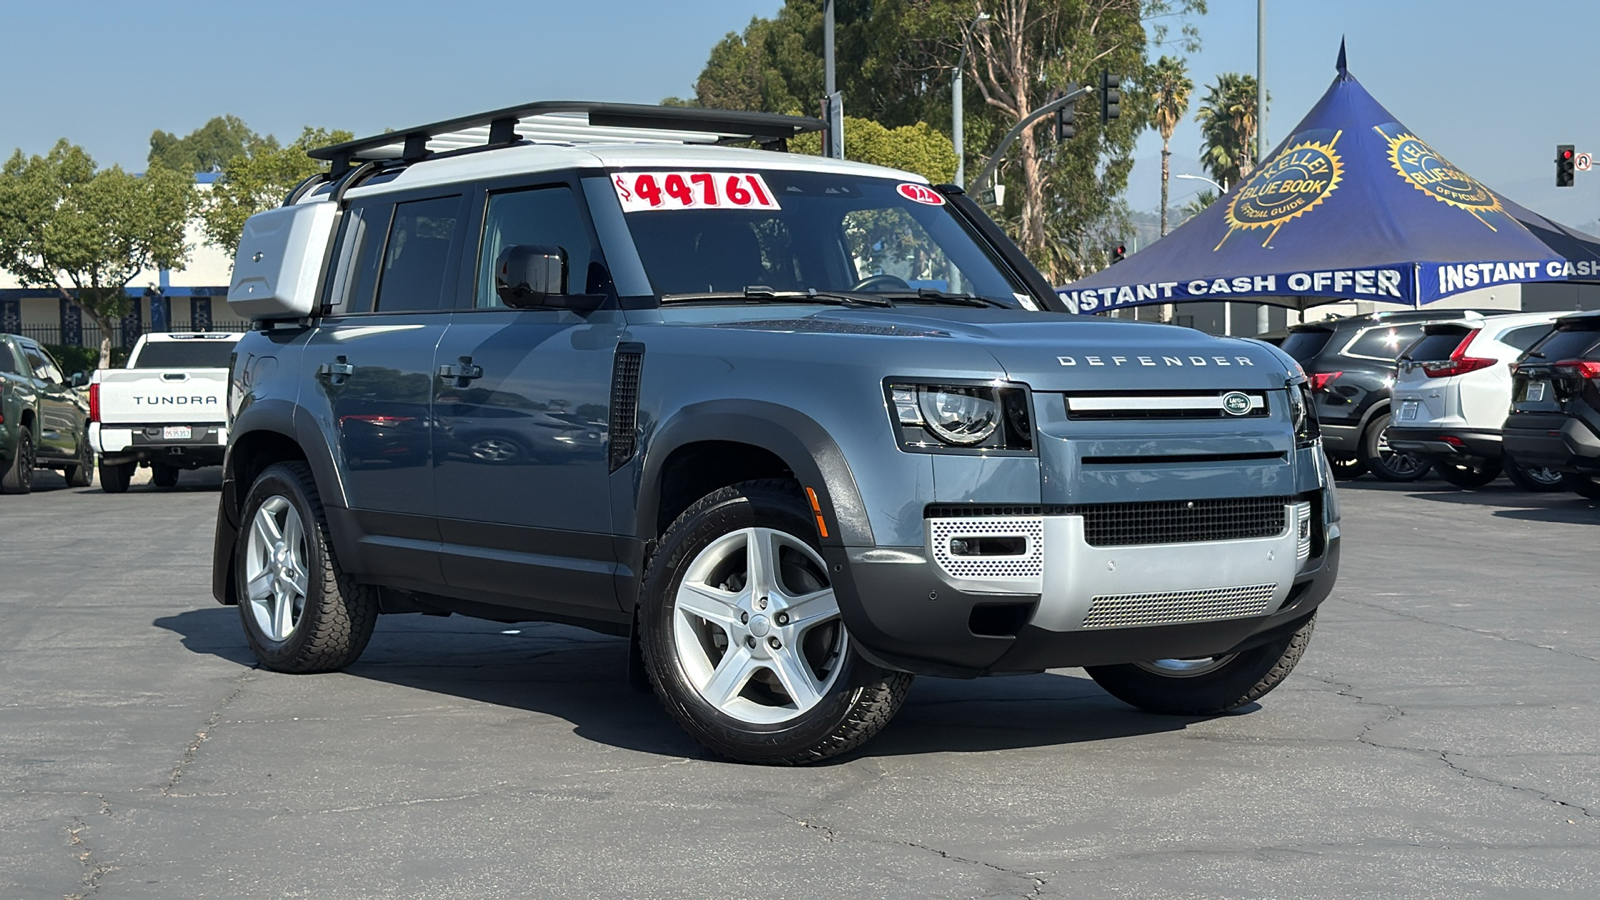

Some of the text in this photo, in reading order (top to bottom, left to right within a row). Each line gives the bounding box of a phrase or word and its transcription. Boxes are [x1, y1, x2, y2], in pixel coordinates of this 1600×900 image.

[1263, 152, 1329, 179] KELLEY
[1410, 168, 1451, 185] BLUE
[616, 173, 770, 206] $44761
[909, 185, 934, 202] 22
[1240, 179, 1327, 200] BLUE BOOK
[1270, 197, 1306, 216] GUIDE
[1438, 260, 1600, 294] INSTANT CASH
[1058, 281, 1178, 315] NSTANT
[1187, 275, 1276, 295] CASH
[1287, 269, 1402, 298] OFFER
[1056, 355, 1255, 367] DEFENDER
[133, 395, 218, 405] TUNDRA
